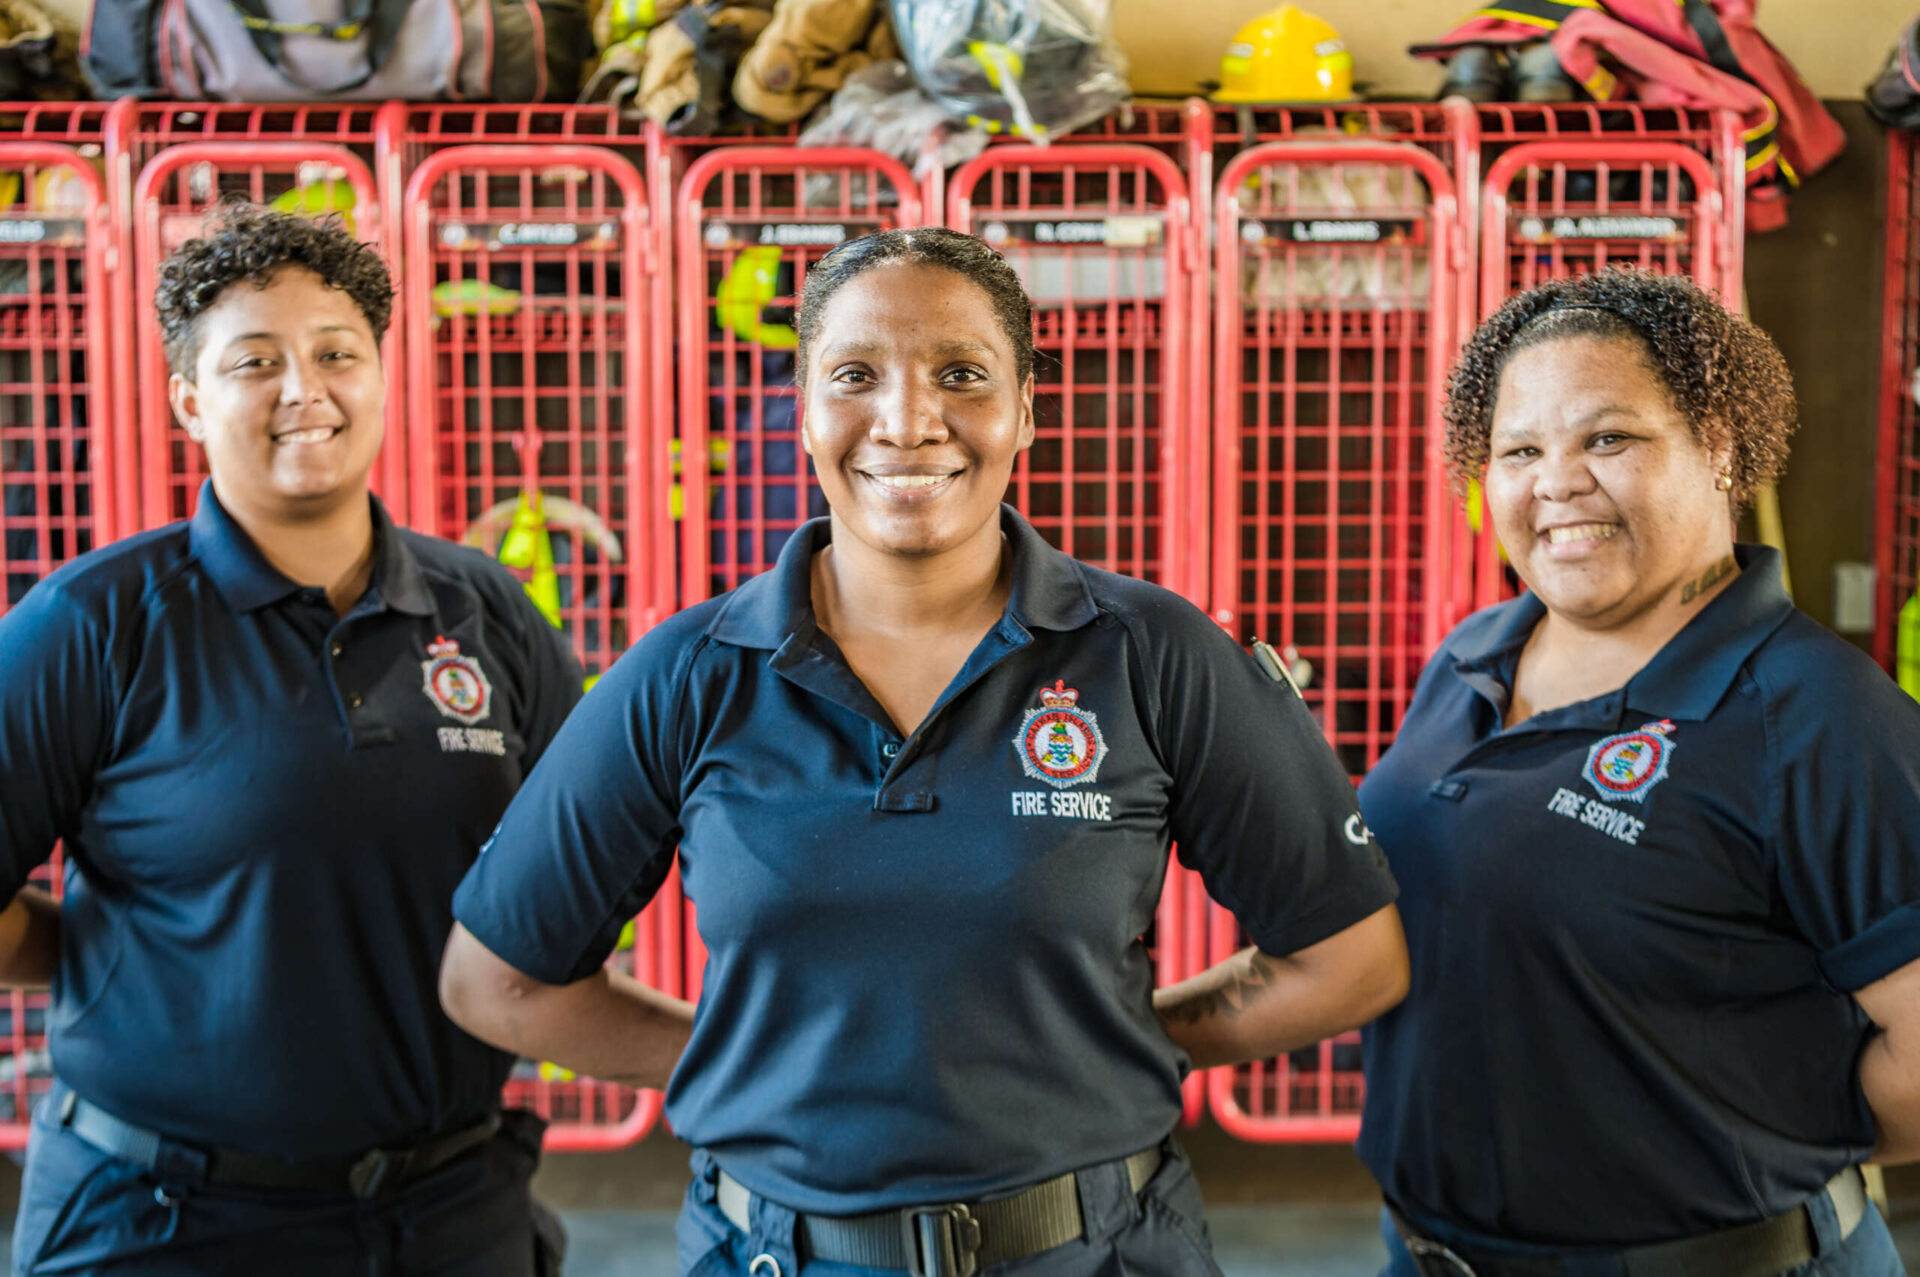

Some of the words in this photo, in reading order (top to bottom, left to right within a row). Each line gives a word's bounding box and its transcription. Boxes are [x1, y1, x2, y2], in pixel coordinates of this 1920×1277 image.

[437, 727, 467, 752] FIRE
[465, 728, 506, 756] SERVICE
[1011, 791, 1048, 816] FIRE
[1051, 791, 1112, 821] SERVICE
[1547, 787, 1587, 819] FIRE
[1580, 799, 1646, 846] SERVICE
